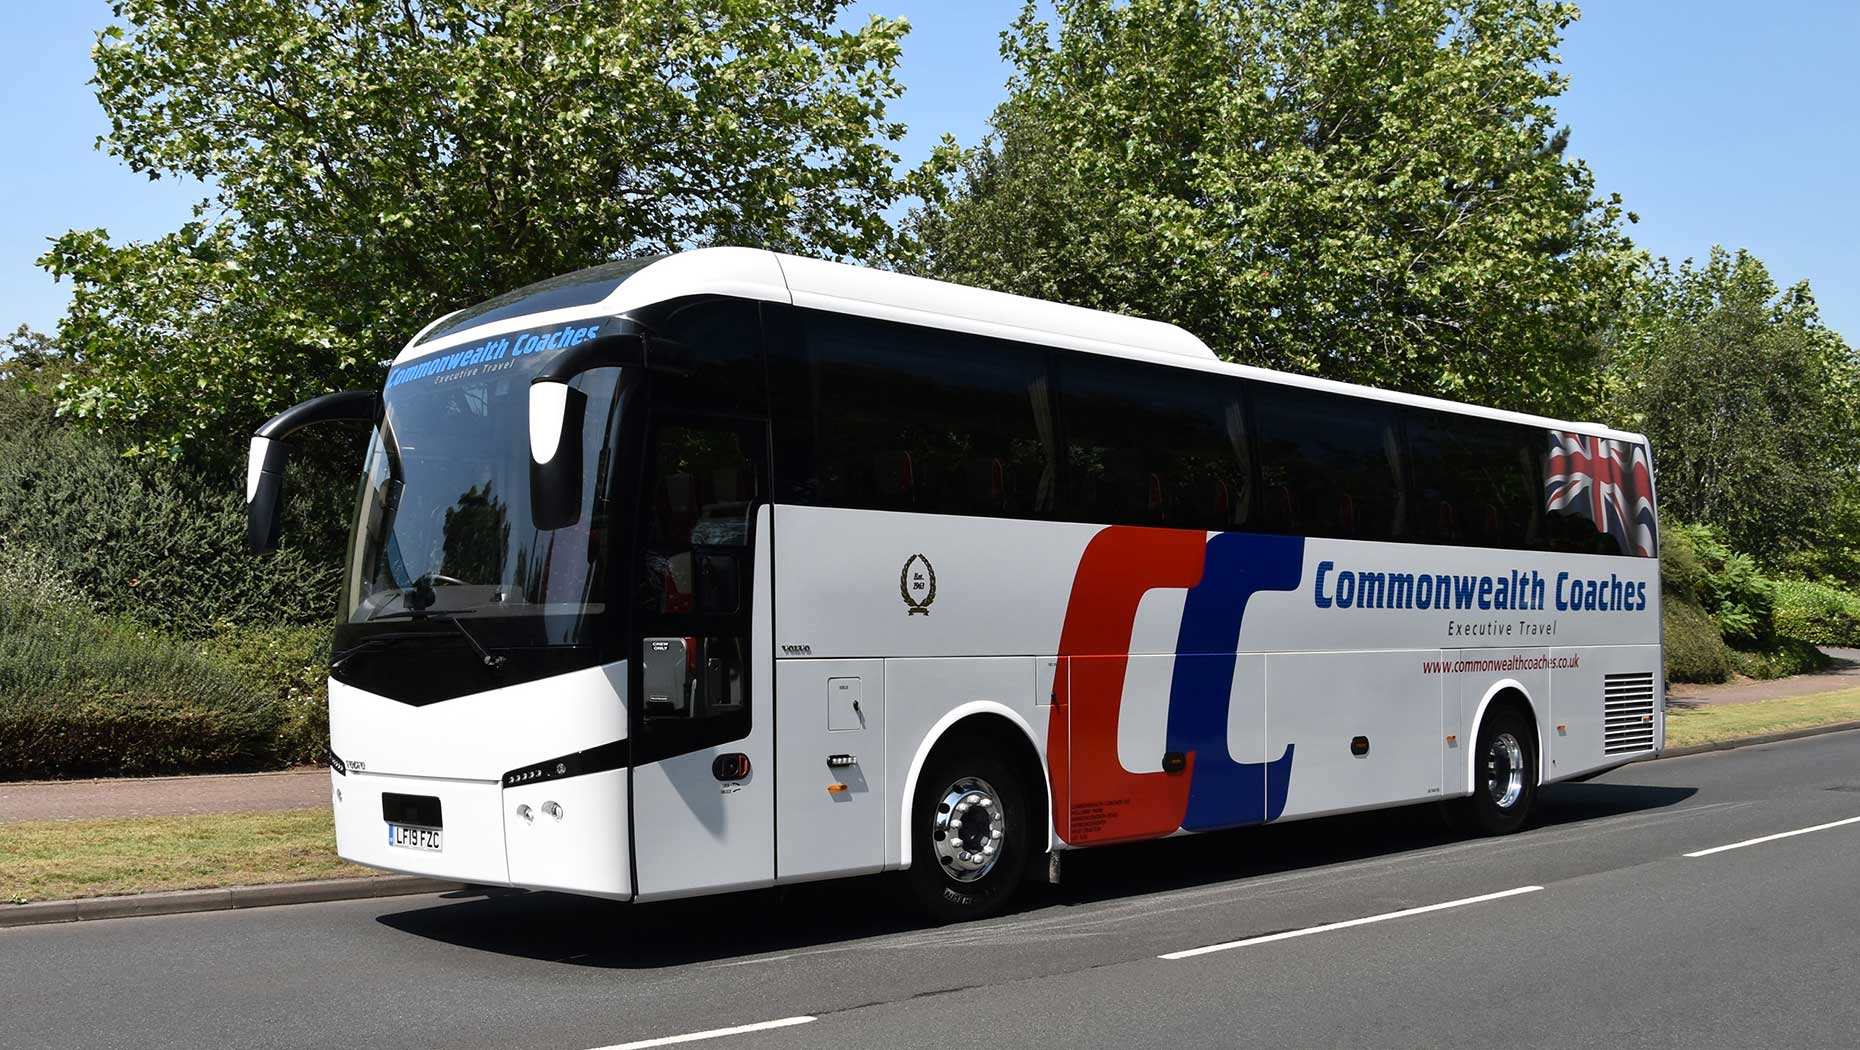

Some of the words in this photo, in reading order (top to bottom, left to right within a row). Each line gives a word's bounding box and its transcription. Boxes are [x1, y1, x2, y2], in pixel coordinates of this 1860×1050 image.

[387, 338, 510, 389] Commonwealth
[512, 325, 600, 357] Coaches
[434, 368, 479, 385] Executive
[483, 358, 515, 374] Travel
[1314, 560, 1545, 611] Commonwealth
[1555, 571, 1647, 611] Coaches
[1447, 620, 1513, 636] Executive
[1519, 620, 1557, 636] Travel
[781, 644, 811, 653] VOLVO
[1423, 653, 1580, 674] www.commonwealthcoaches.co.uk
[396, 827, 418, 846] LF19
[420, 830, 440, 849] FZC
